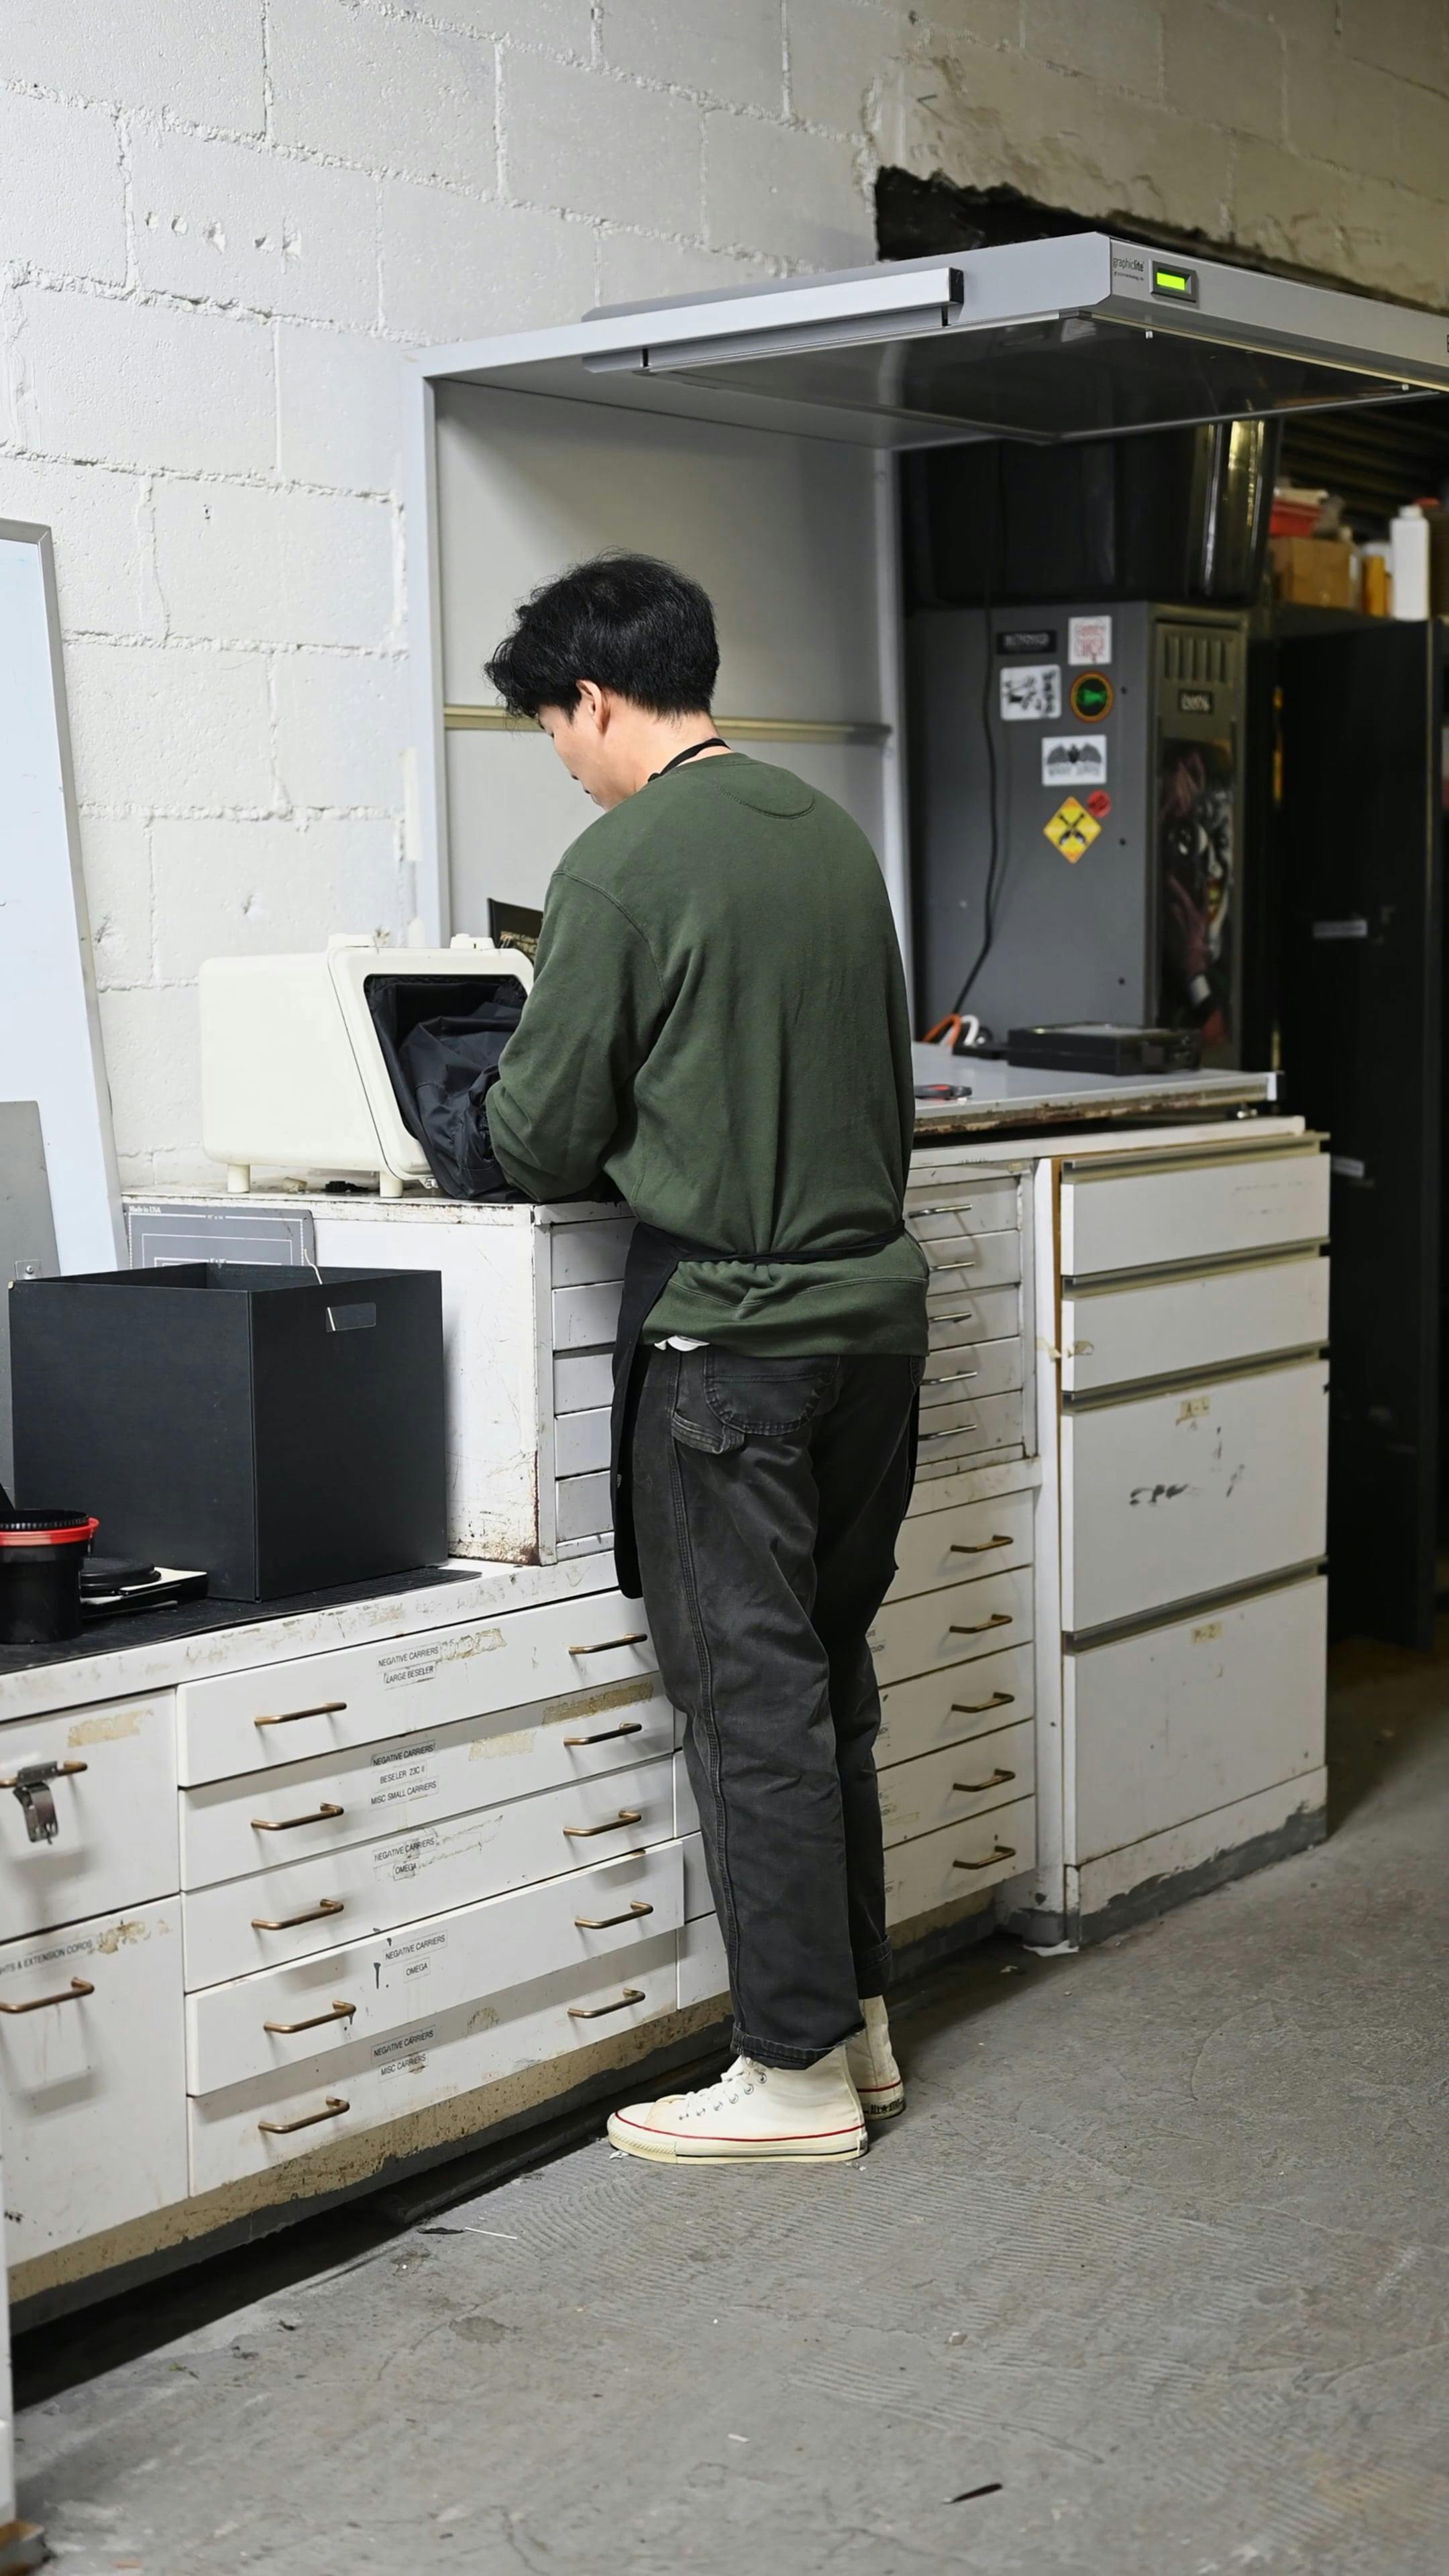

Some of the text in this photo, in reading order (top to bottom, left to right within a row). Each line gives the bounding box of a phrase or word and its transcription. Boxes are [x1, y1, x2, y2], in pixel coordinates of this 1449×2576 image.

[378, 1646, 439, 1667] NEGATIVE CARRIERS
[386, 1665, 434, 1684] LARGE BESELER
[373, 1744, 434, 1766] NEGATIVE CARRIERS
[380, 1770, 407, 1784] BESELER
[409, 1766, 420, 1776] 23C
[370, 1780, 437, 1805] MISC SMALL CARRIERS
[374, 1837, 435, 1862] NEGATIVE CARRIERS
[394, 1862, 417, 1875] OMEGA
[23, 1949, 65, 1968] EXTENSION
[385, 1935, 445, 1961] NEGATIVE CARRIERS
[405, 1962, 428, 1976] OMEGA
[374, 2030, 435, 2056] NEGATIVE CARRIERS
[380, 2054, 426, 2076] MISC CARRIERS
